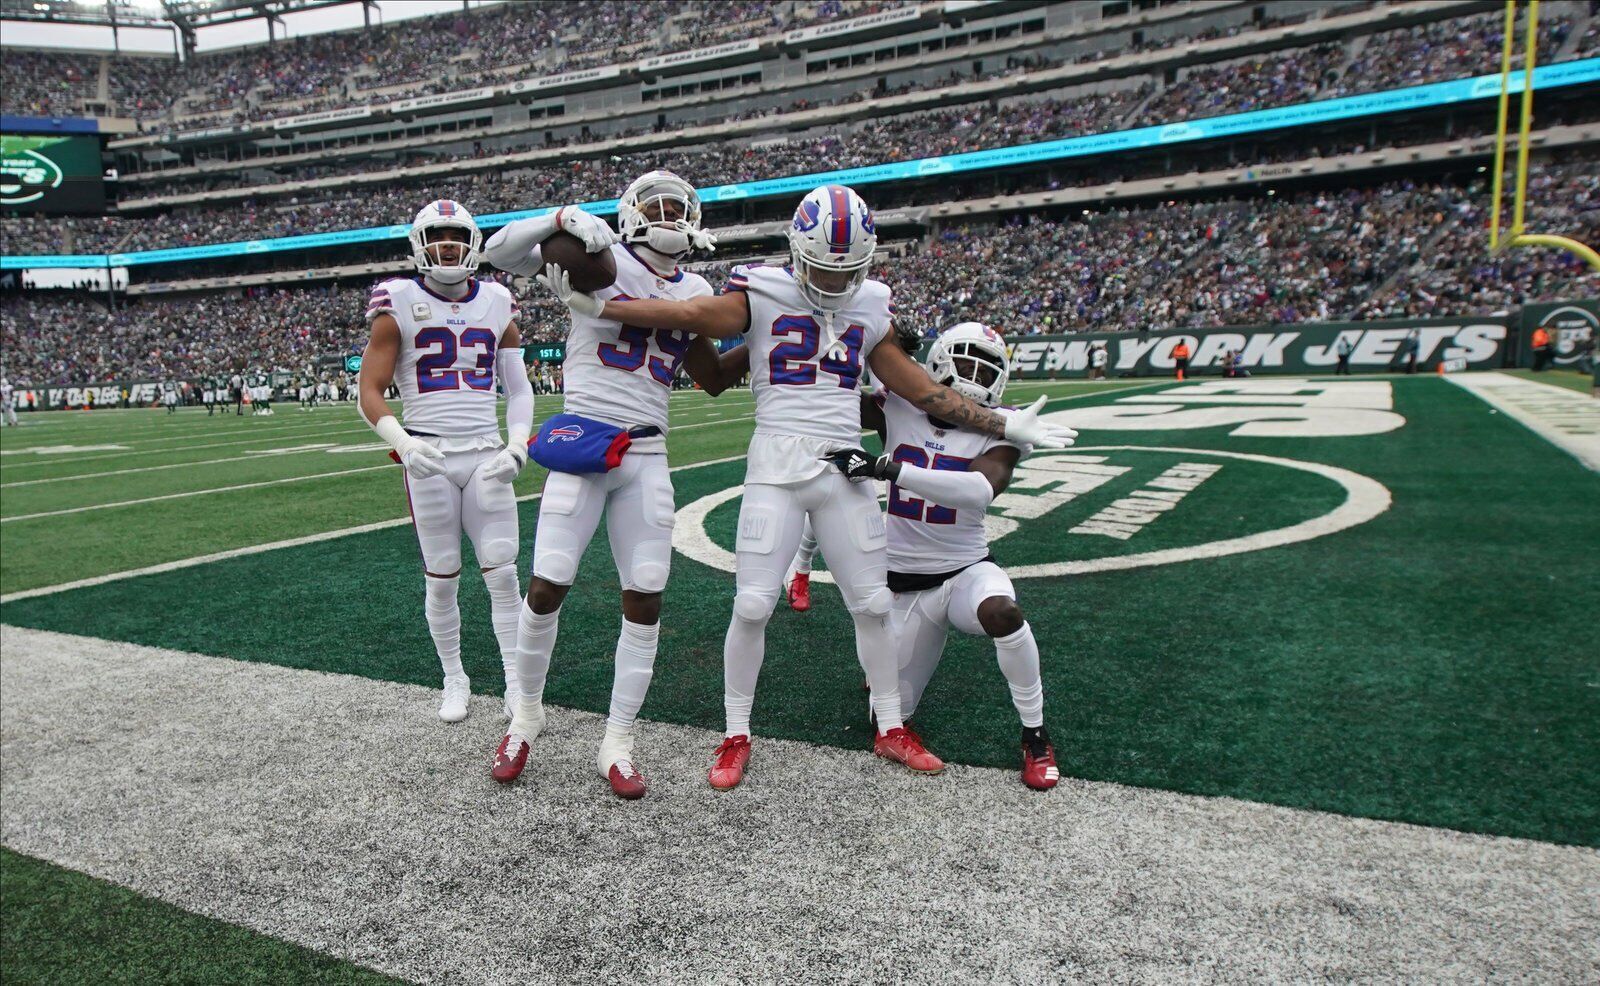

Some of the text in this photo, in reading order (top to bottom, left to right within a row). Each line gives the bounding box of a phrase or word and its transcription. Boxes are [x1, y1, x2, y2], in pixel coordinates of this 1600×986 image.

[415, 327, 497, 394] 23
[540, 349, 562, 358] 1ST &
[769, 314, 865, 391] 24
[1115, 332, 1300, 369] YORK
[1303, 325, 1507, 366] JETS
[848, 460, 868, 474] adidas
[925, 440, 945, 451] BILLS
[1068, 462, 1224, 540] NEW YORK
